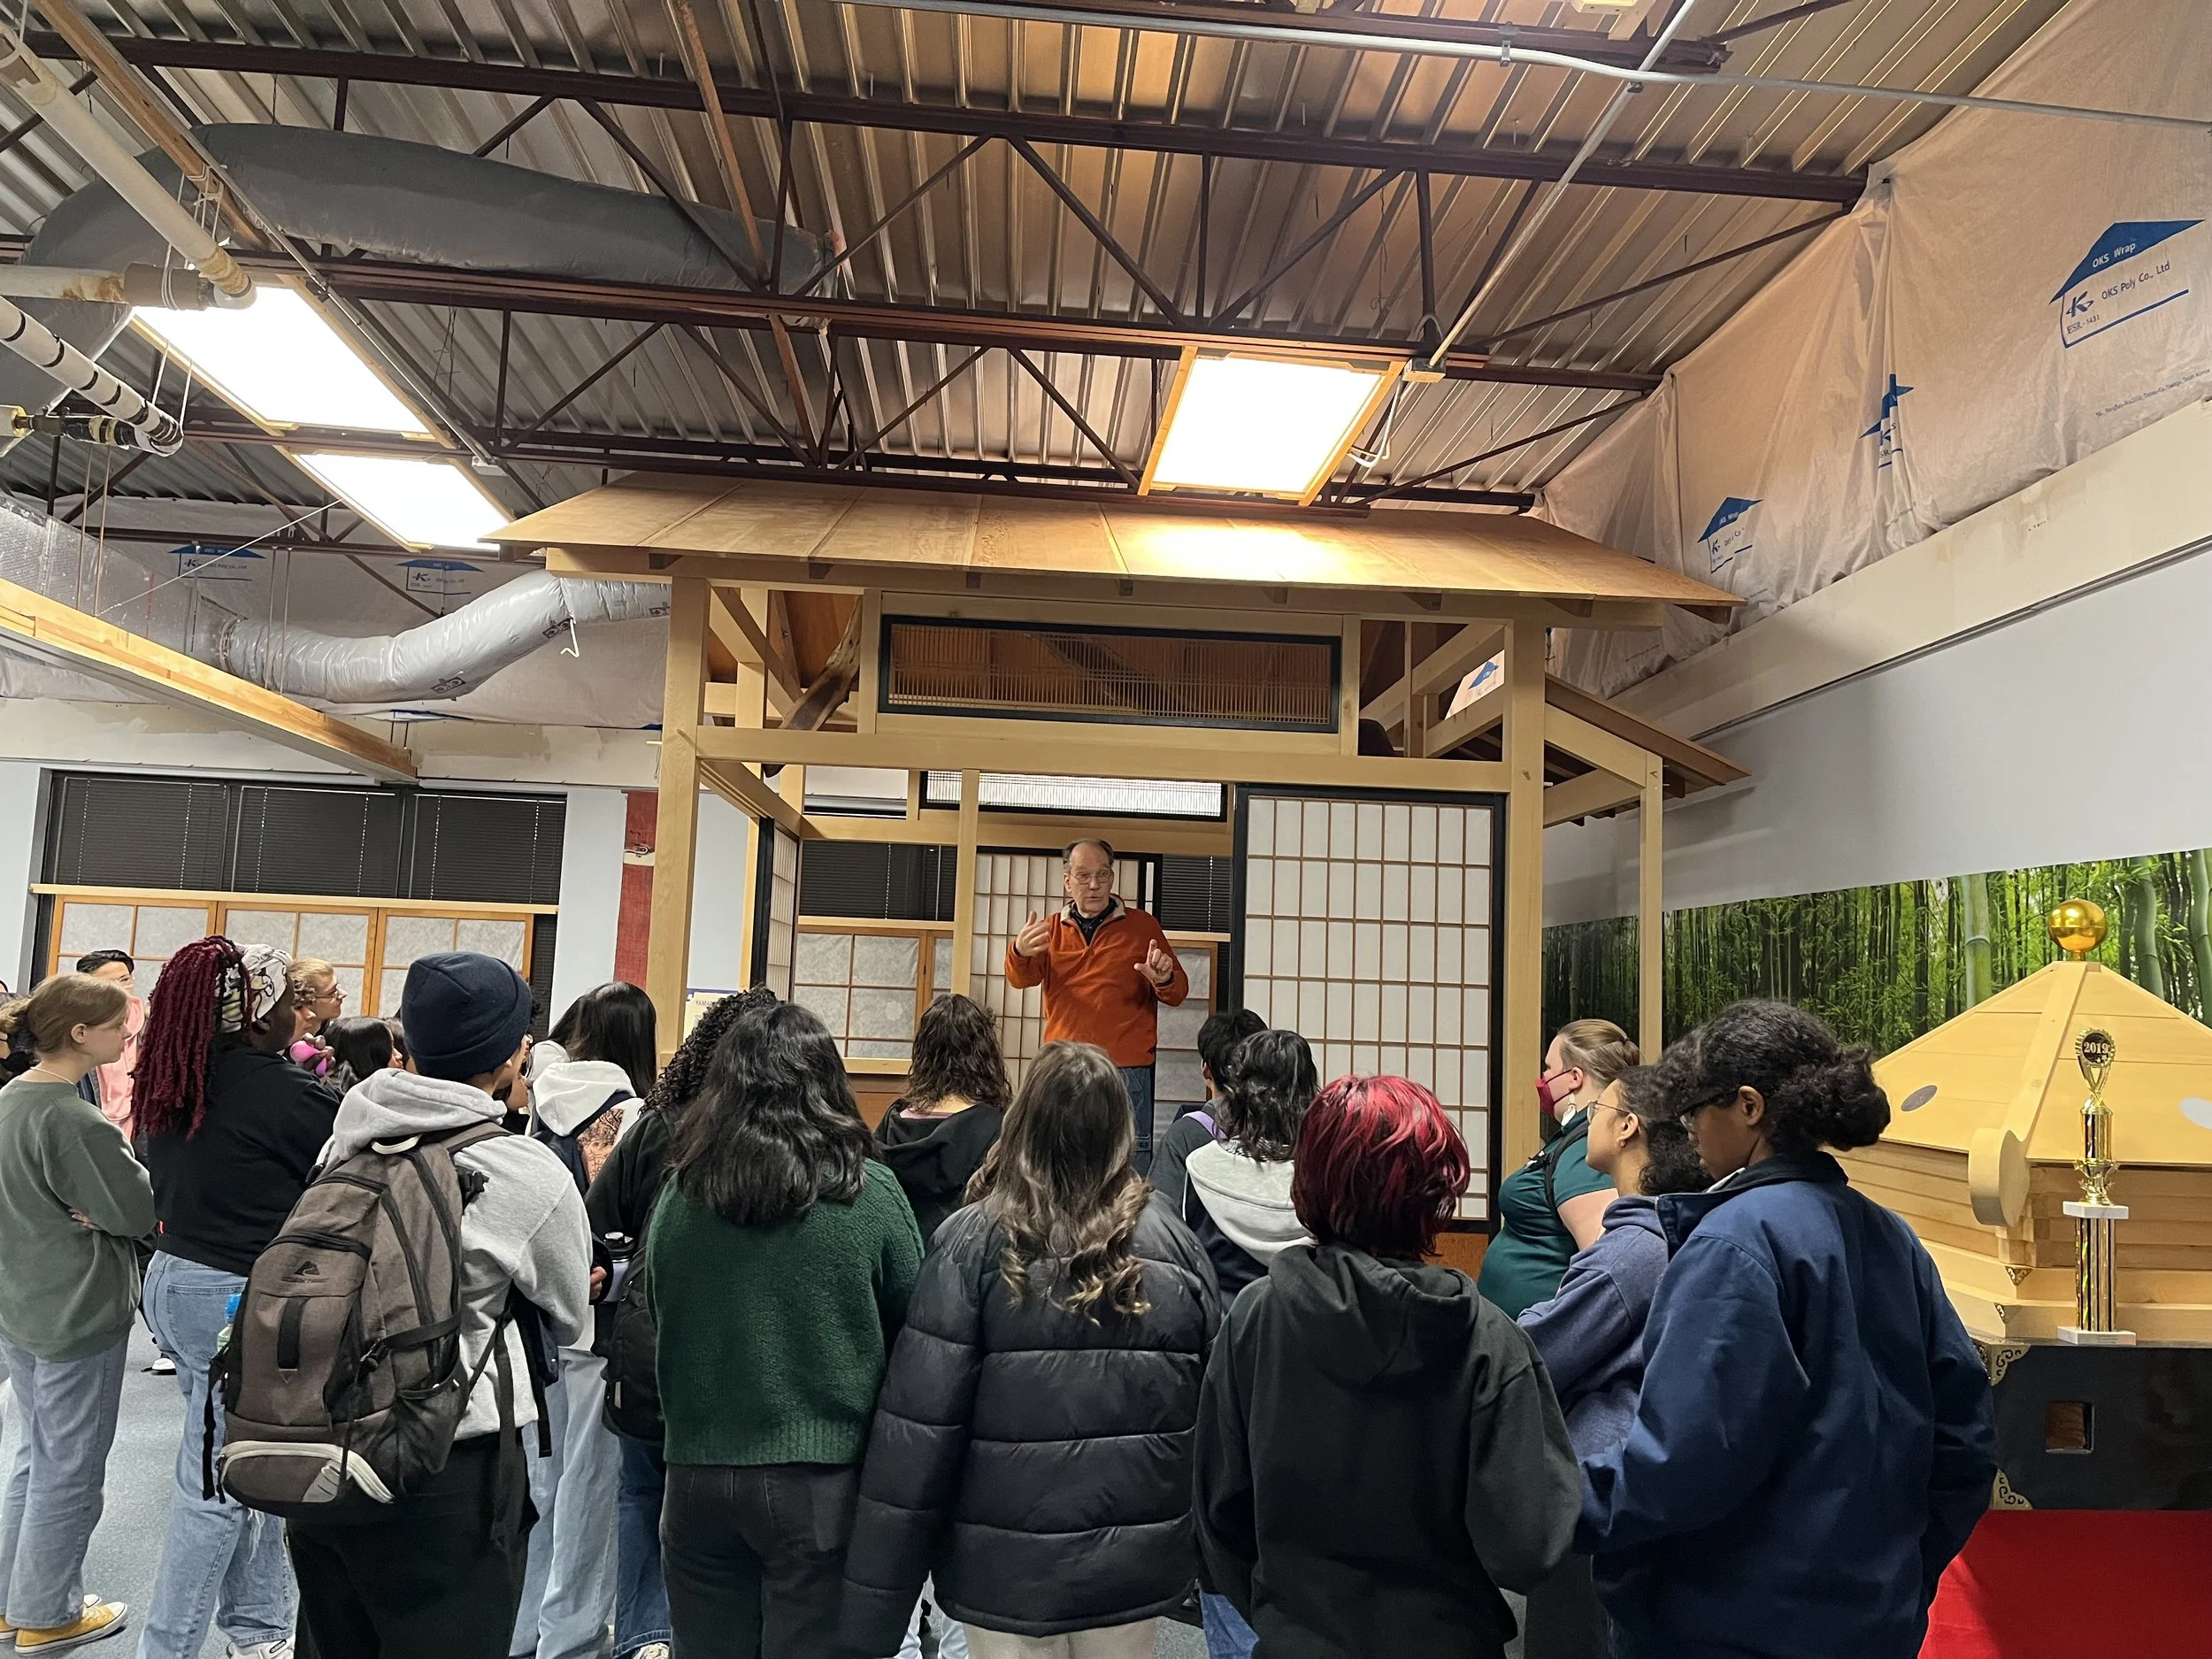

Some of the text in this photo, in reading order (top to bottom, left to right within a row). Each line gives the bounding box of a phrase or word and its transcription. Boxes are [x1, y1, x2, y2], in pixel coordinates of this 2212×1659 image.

[2093, 242, 2136, 267] OKS Wrap
[2101, 286, 2118, 300] OKS
[2120, 278, 2136, 293] Poly
[2156, 261, 2170, 275] Ltd
[2084, 1041, 2109, 1054] 2019
